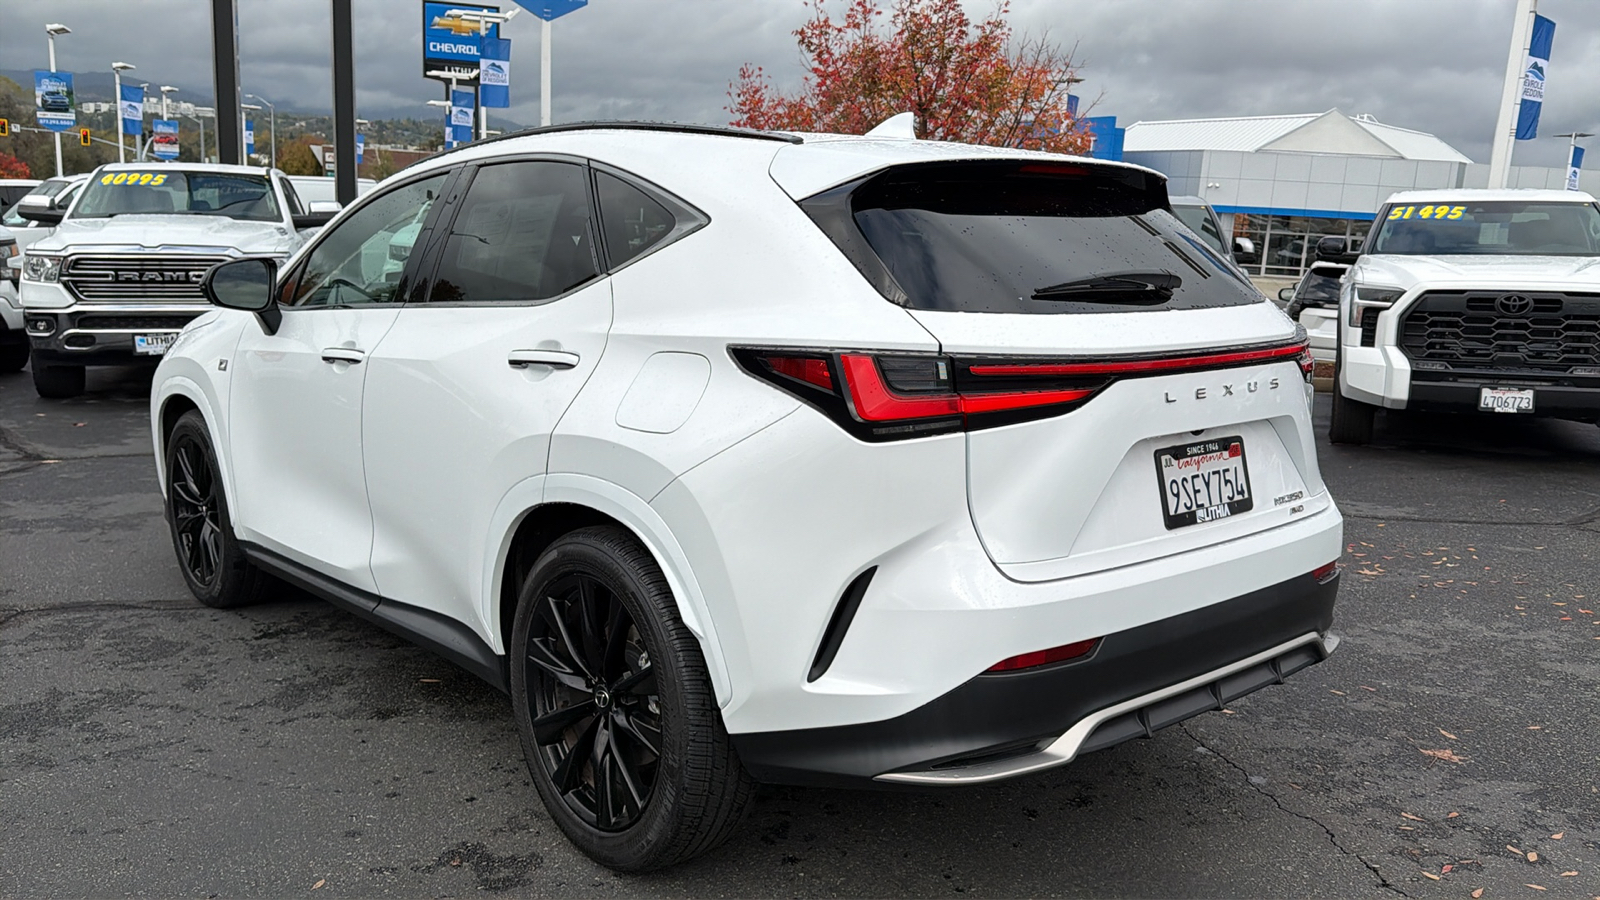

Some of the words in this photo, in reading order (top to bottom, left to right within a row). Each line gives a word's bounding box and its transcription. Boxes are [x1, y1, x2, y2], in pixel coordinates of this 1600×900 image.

[430, 41, 480, 55] CHEVROL
[1523, 79, 1544, 90] EVROLE
[101, 173, 166, 186] 40995
[1388, 206, 1415, 220] 51
[1419, 205, 1466, 220] 495
[118, 271, 187, 281] RAM
[1164, 378, 1280, 404] LEXUS
[1483, 396, 1532, 409] 47067Z3
[1186, 444, 1205, 455] SINCE
[1206, 442, 1219, 452] 1946
[1164, 457, 1174, 468] JUL
[1177, 452, 1230, 471] California
[1170, 466, 1246, 514] 9SEY754
[1204, 503, 1232, 521] LITHIA
